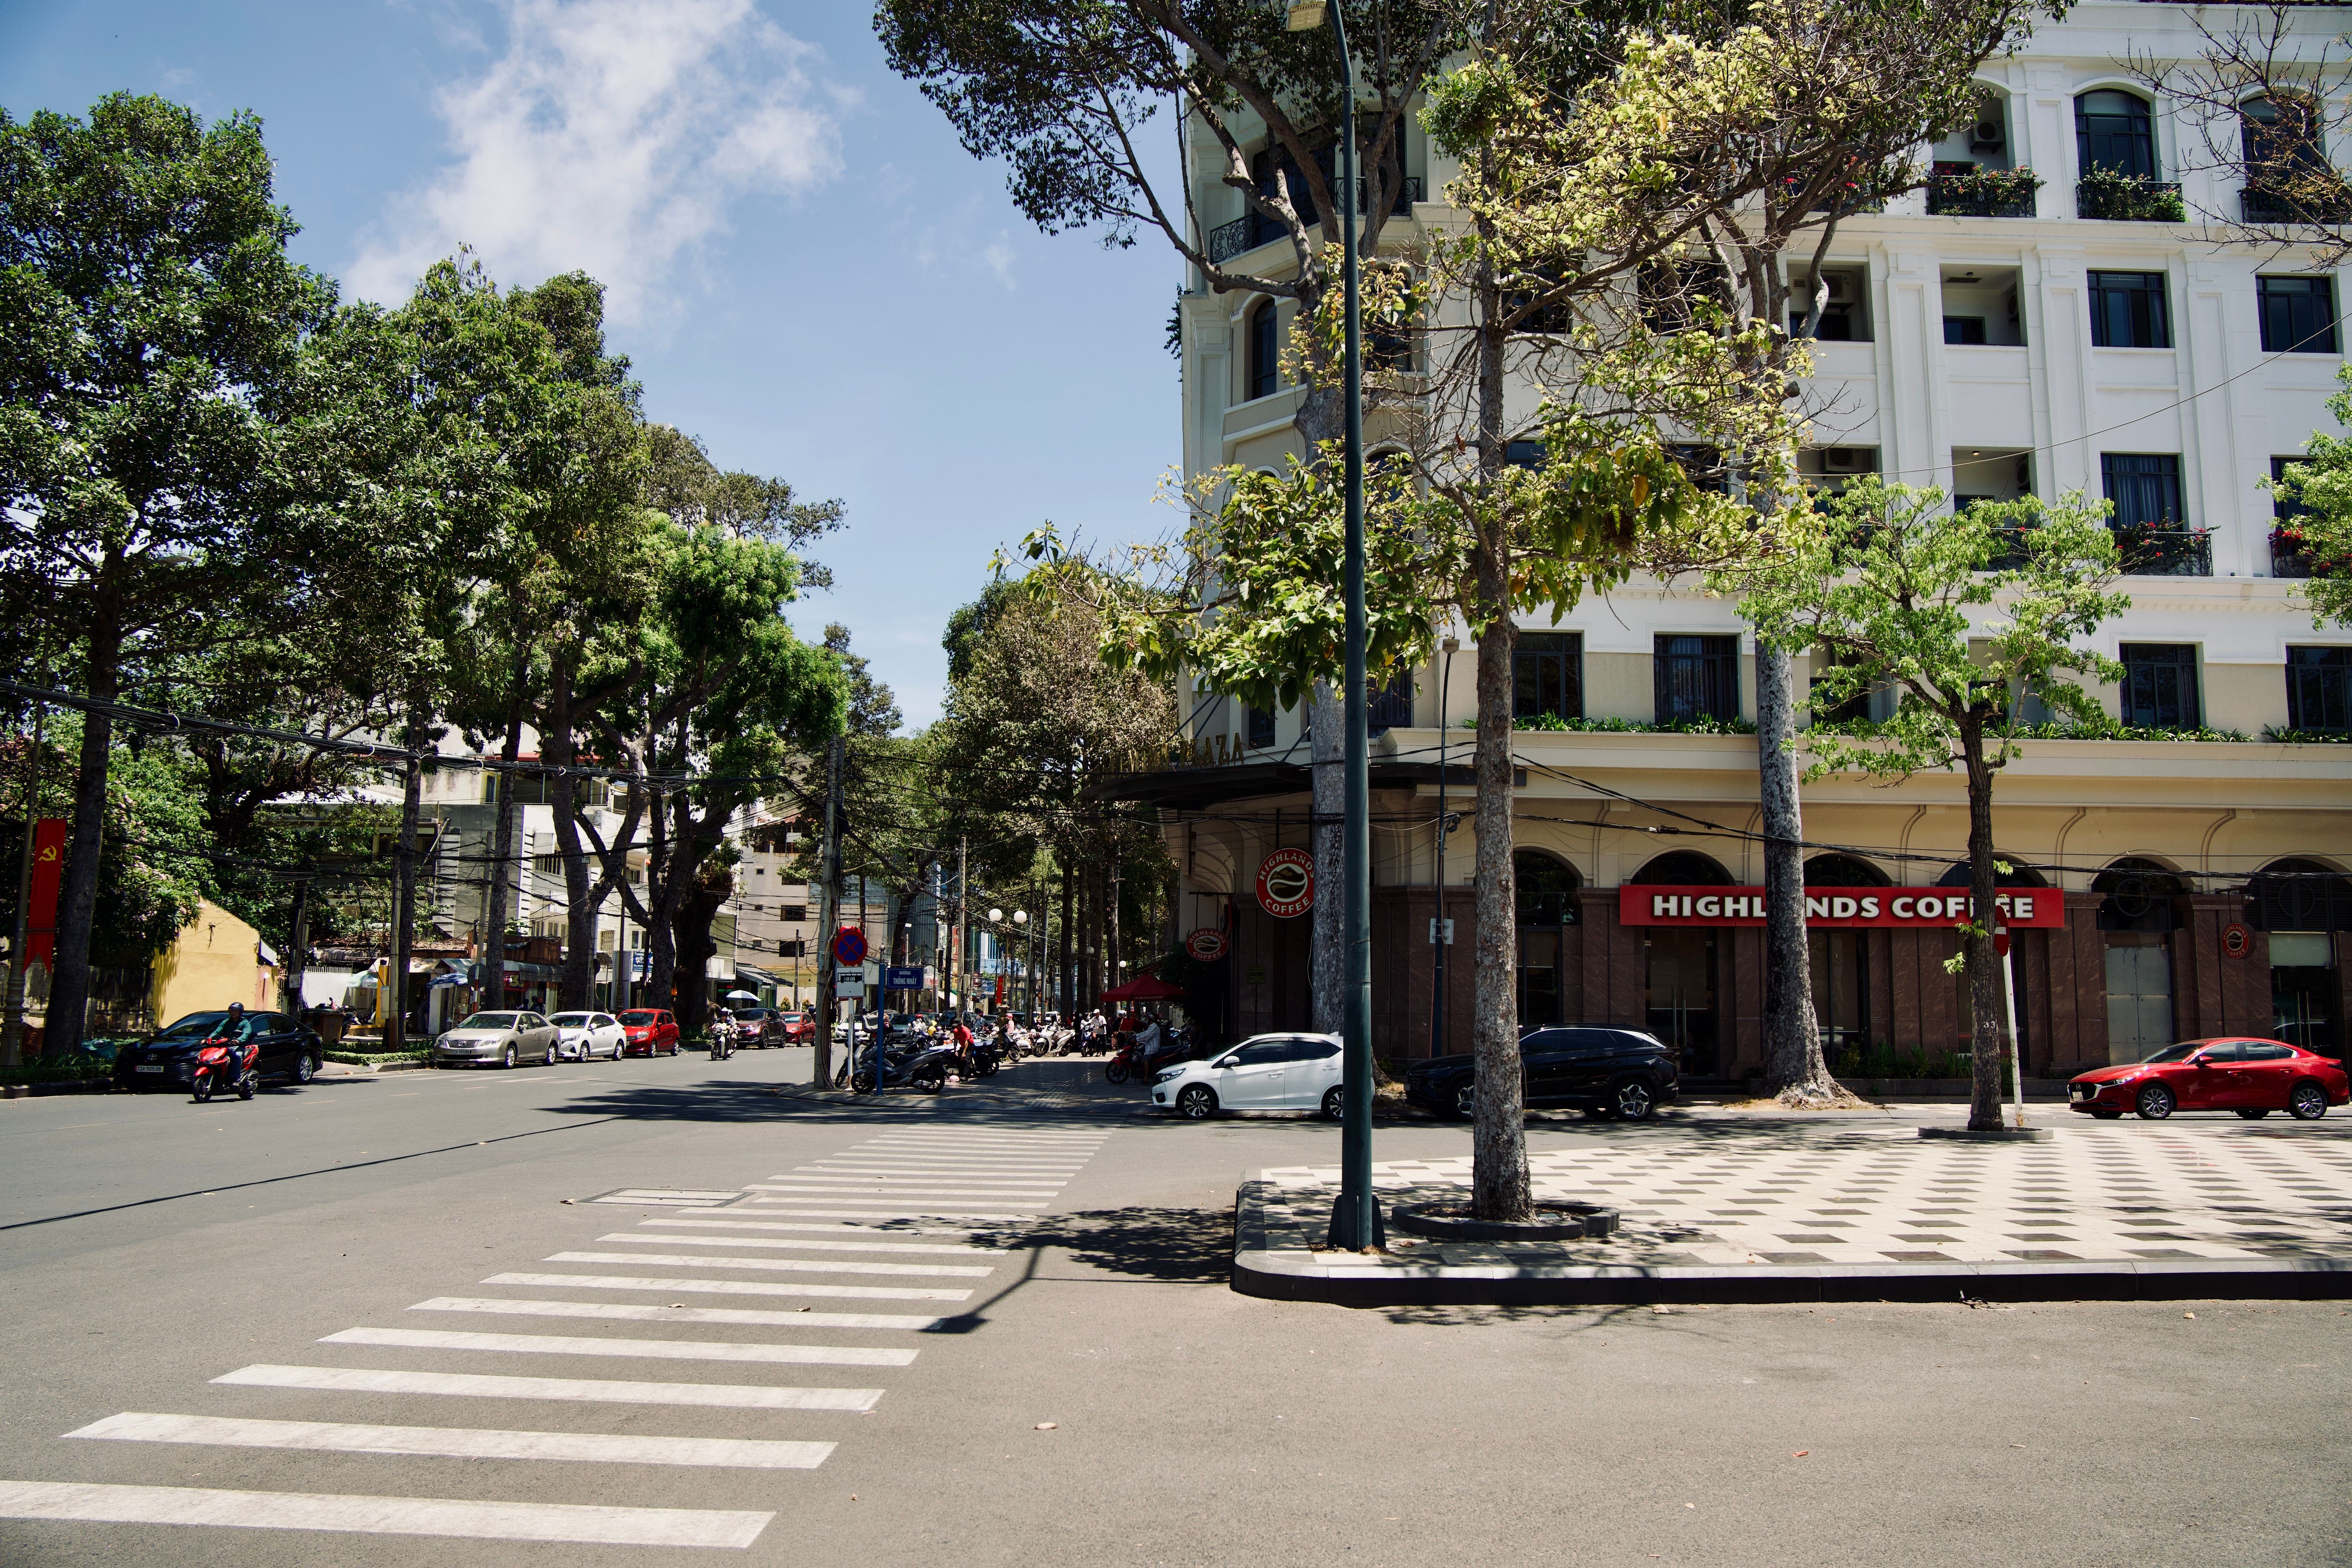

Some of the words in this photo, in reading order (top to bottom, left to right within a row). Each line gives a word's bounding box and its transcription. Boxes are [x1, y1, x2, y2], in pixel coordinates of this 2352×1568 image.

[1265, 897, 1310, 913] COFFEE
[1653, 895, 1880, 918] HIGHLNDS
[1892, 897, 2033, 918] COFEE
[1189, 930, 1226, 943] HIGHLANDS
[2223, 925, 2247, 940] HIGHLANDS
[1193, 951, 1222, 959] COFFEE
[2227, 947, 2245, 956] COFFEE
[893, 975, 906, 984] THỐNG
[906, 975, 917, 984] NHẤT
